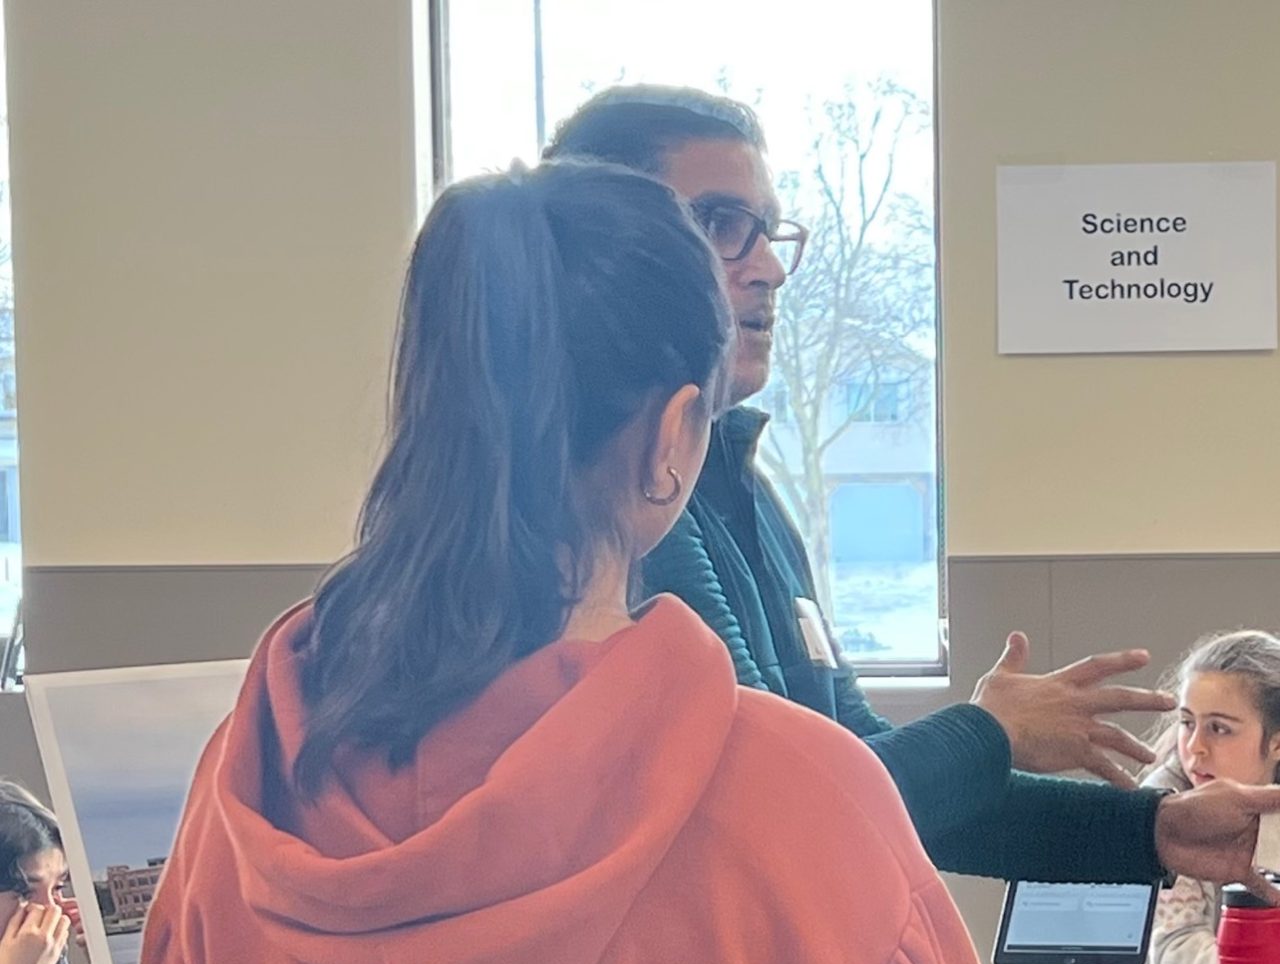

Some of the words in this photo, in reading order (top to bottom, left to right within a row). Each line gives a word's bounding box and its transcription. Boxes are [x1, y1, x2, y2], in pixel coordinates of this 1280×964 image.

[1081, 213, 1188, 235] Science
[1110, 245, 1159, 266] and
[1063, 278, 1214, 303] Technology
